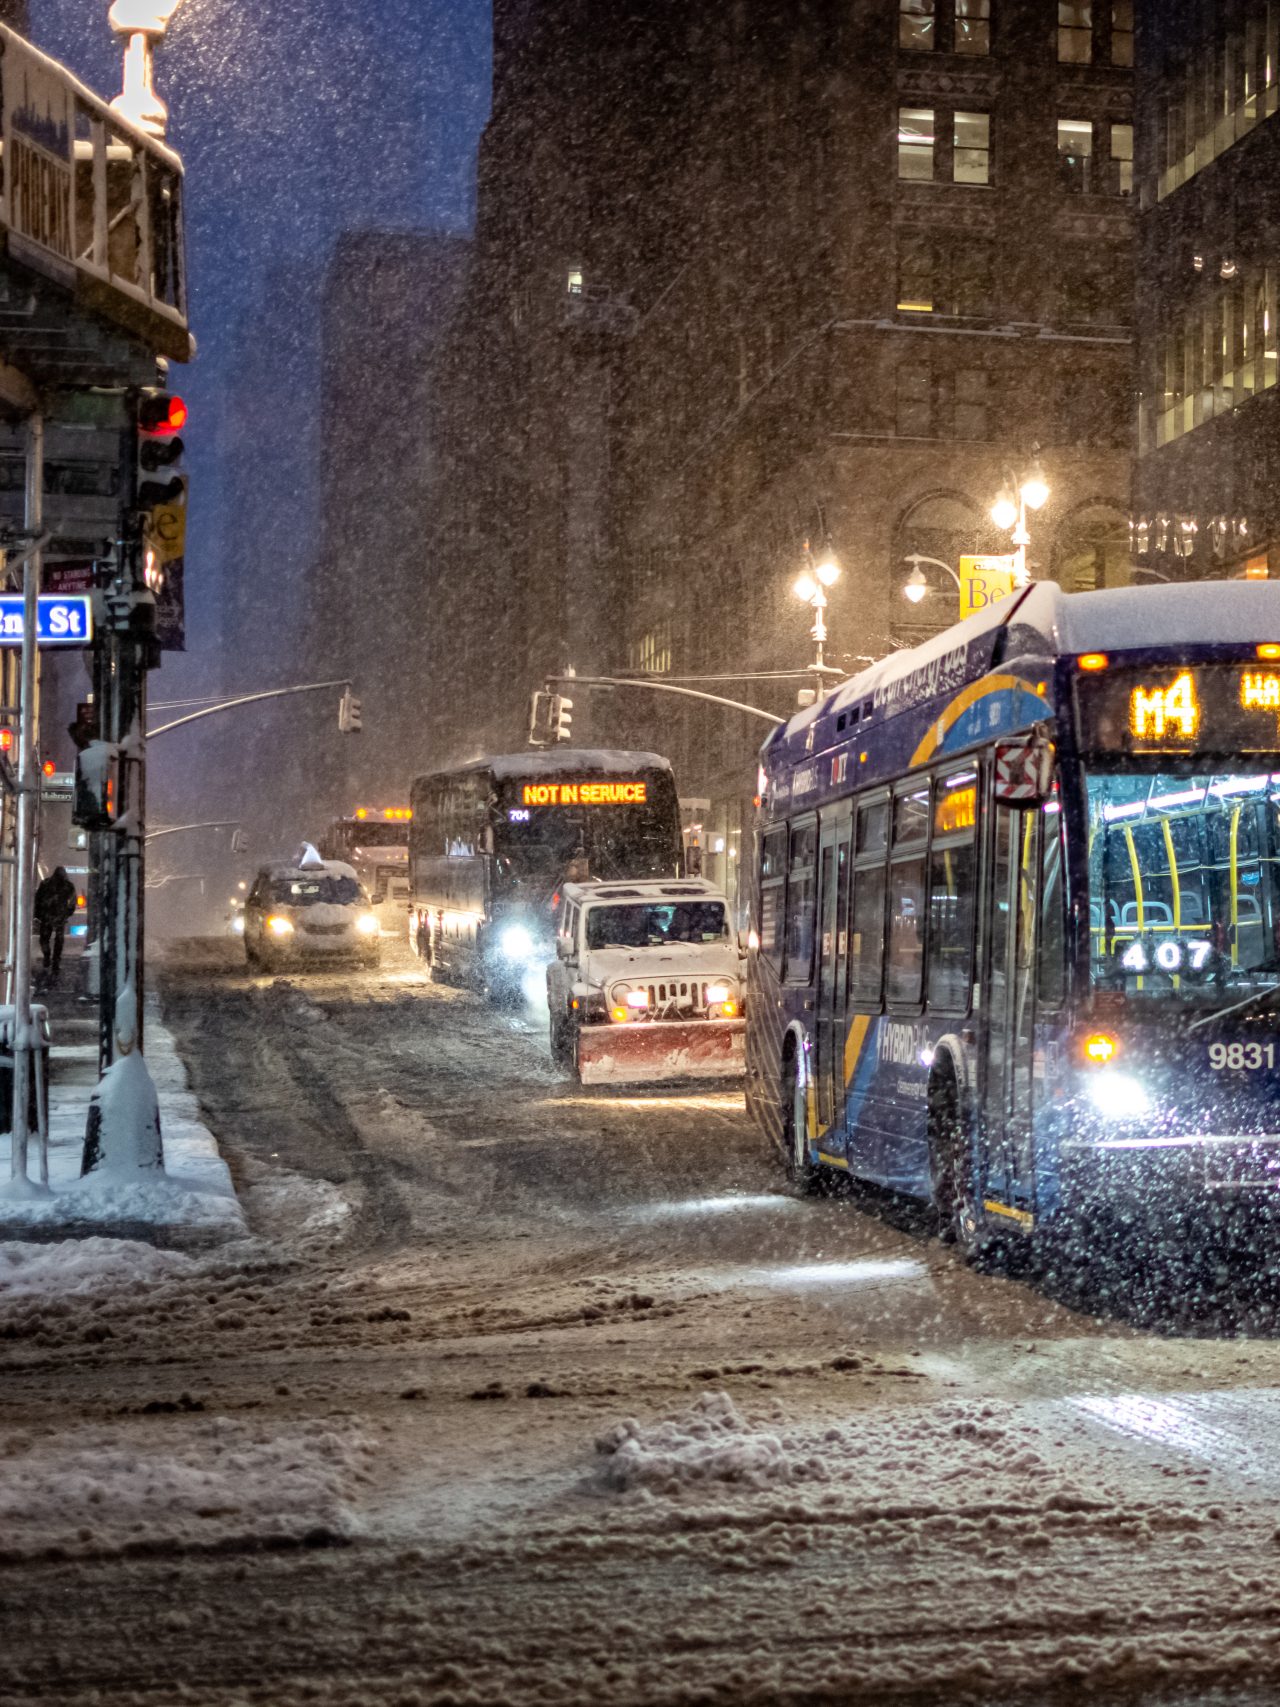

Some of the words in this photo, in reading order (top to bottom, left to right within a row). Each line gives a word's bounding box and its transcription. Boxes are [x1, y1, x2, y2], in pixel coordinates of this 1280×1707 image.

[49, 606, 81, 633] St
[1134, 671, 1197, 734] M4
[523, 784, 559, 804] NOT
[560, 783, 579, 803] IN
[579, 781, 646, 803] SERVICE
[509, 809, 529, 821] 704
[1122, 941, 1212, 971] 407
[1208, 1042, 1275, 1070] 9831
